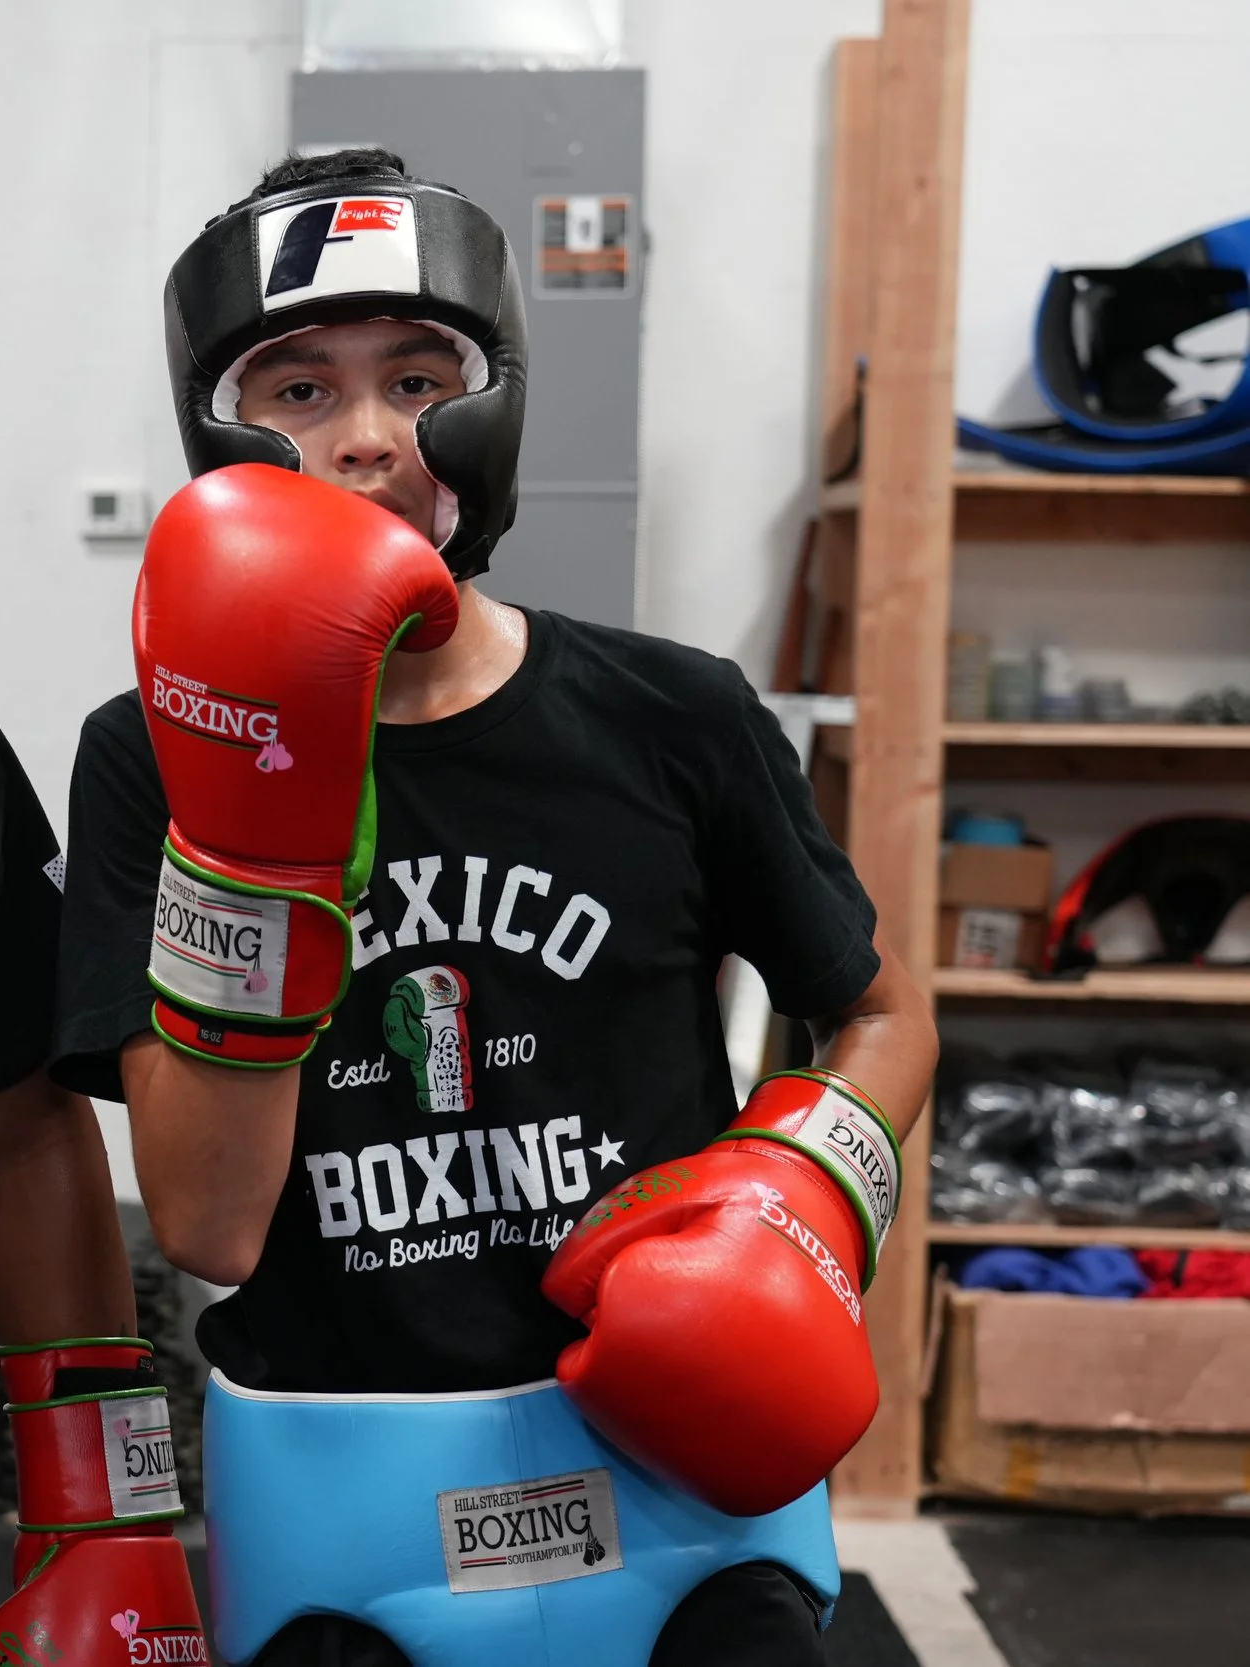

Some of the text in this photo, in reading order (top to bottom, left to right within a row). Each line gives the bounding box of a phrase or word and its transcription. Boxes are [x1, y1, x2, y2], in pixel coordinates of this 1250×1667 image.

[155, 664, 208, 695] HILL STREET
[152, 677, 278, 742] BOXING
[173, 880, 197, 904] STREET
[351, 855, 611, 980] EXICO
[156, 892, 262, 962] BOXING
[327, 1053, 391, 1090] Estd
[484, 1033, 536, 1069] 1810
[305, 1115, 591, 1238] BOXING
[827, 1124, 889, 1221] OXING
[345, 1244, 383, 1272] No
[390, 1229, 479, 1268] Boxing
[489, 1218, 525, 1248] No
[759, 1206, 862, 1323] BOXING
[454, 1490, 521, 1513] HILL STREET
[454, 1498, 591, 1554] BOXING
[507, 1542, 584, 1566] SOUTHAMPTON, NY
[130, 1634, 207, 1666] BOXING
